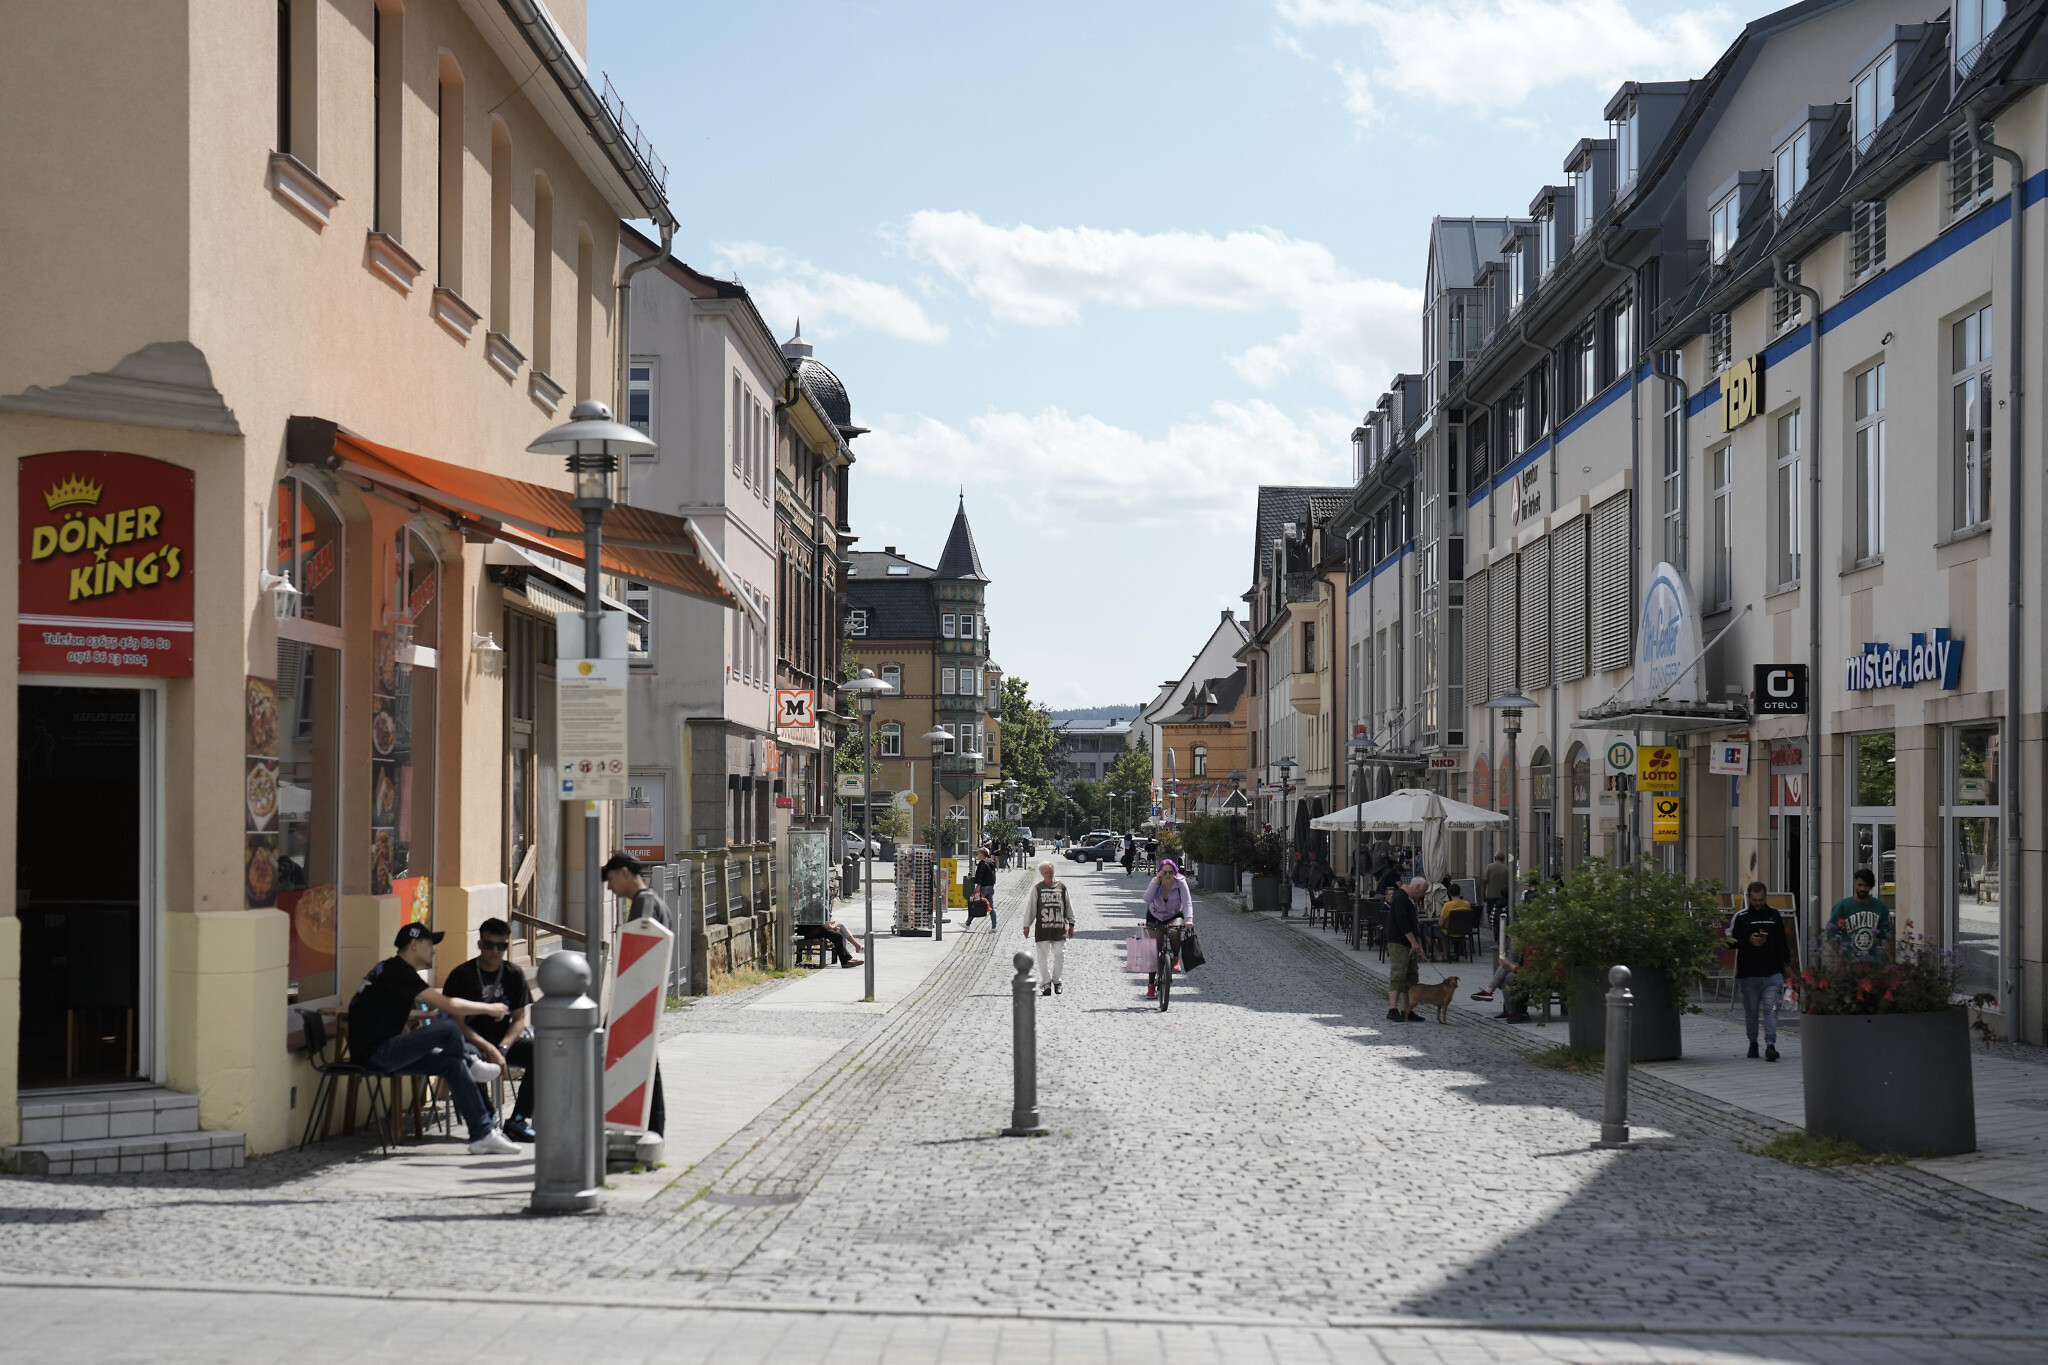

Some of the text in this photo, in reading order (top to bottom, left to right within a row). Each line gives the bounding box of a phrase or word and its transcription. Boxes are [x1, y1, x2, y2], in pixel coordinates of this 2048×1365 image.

[1719, 353, 1757, 433] TEDi
[1522, 464, 1539, 495] Agentur
[1528, 490, 1541, 518] Arbeit
[31, 505, 161, 560] DÖNER
[69, 544, 181, 601] KING'S
[43, 632, 171, 650] Telefon 03675 469 80 80
[66, 650, 148, 667] 0176 86 23 1004
[1846, 628, 1951, 691] mister lady
[785, 700, 805, 715] M
[109, 712, 137, 722] PIZZA
[1431, 759, 1455, 768] NKD
[1615, 748, 1626, 764] H
[1642, 771, 1678, 781] LOTTO
[1646, 782, 1675, 790] Thüringen
